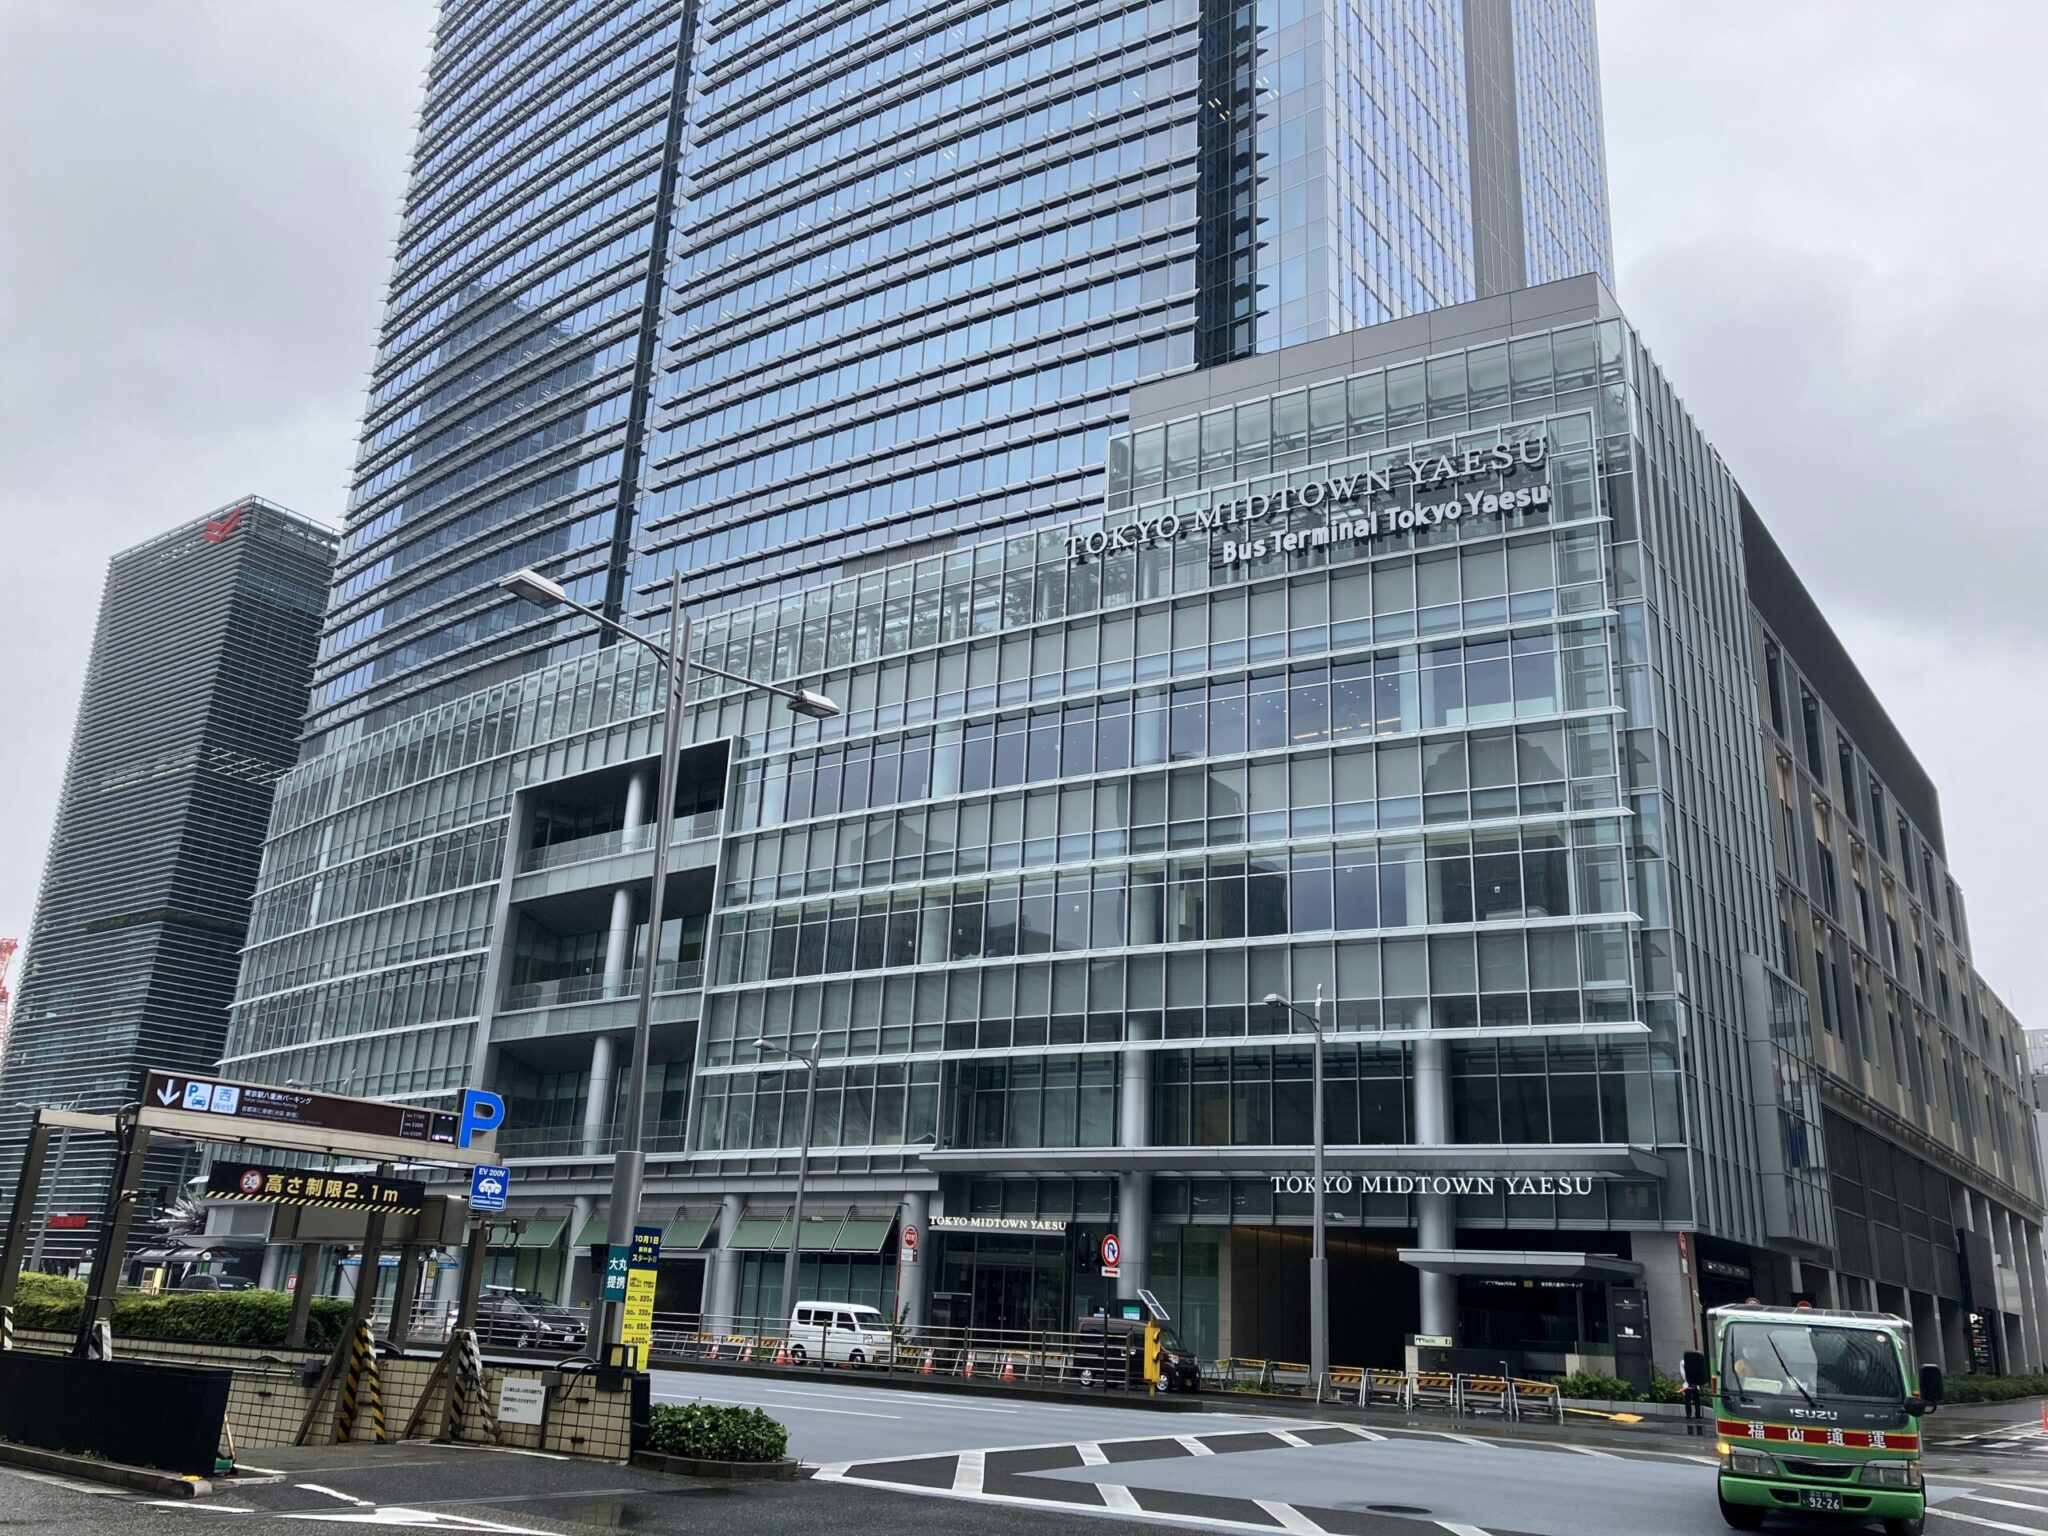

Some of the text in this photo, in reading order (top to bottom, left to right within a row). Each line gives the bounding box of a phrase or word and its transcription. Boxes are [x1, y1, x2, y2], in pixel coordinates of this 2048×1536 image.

[1064, 436, 1548, 560] TOKYO MIDTOWN YAESU
[1222, 483, 1550, 565] Bus Terminal Tokyo Yaesu
[188, 1084, 199, 1097] P
[219, 1088, 232, 1102] 西
[213, 1102, 234, 1112] West
[458, 1088, 505, 1148] P
[478, 1167, 505, 1178] EV 200V
[264, 1173, 399, 1203] 高さ制限2.1m
[1270, 1176, 1593, 1196] TOKYO MIDTOWN YAESU
[929, 1216, 1067, 1231] TOKYO MIDTOWN YAESU
[634, 1235, 660, 1245] 10月1日
[608, 1257, 628, 1271] 大丸
[606, 1275, 626, 1290] 提携
[1789, 1408, 1838, 1420] ISUZU
[1748, 1420, 1887, 1449] 福山通運
[1809, 1496, 1840, 1510] 92-26
